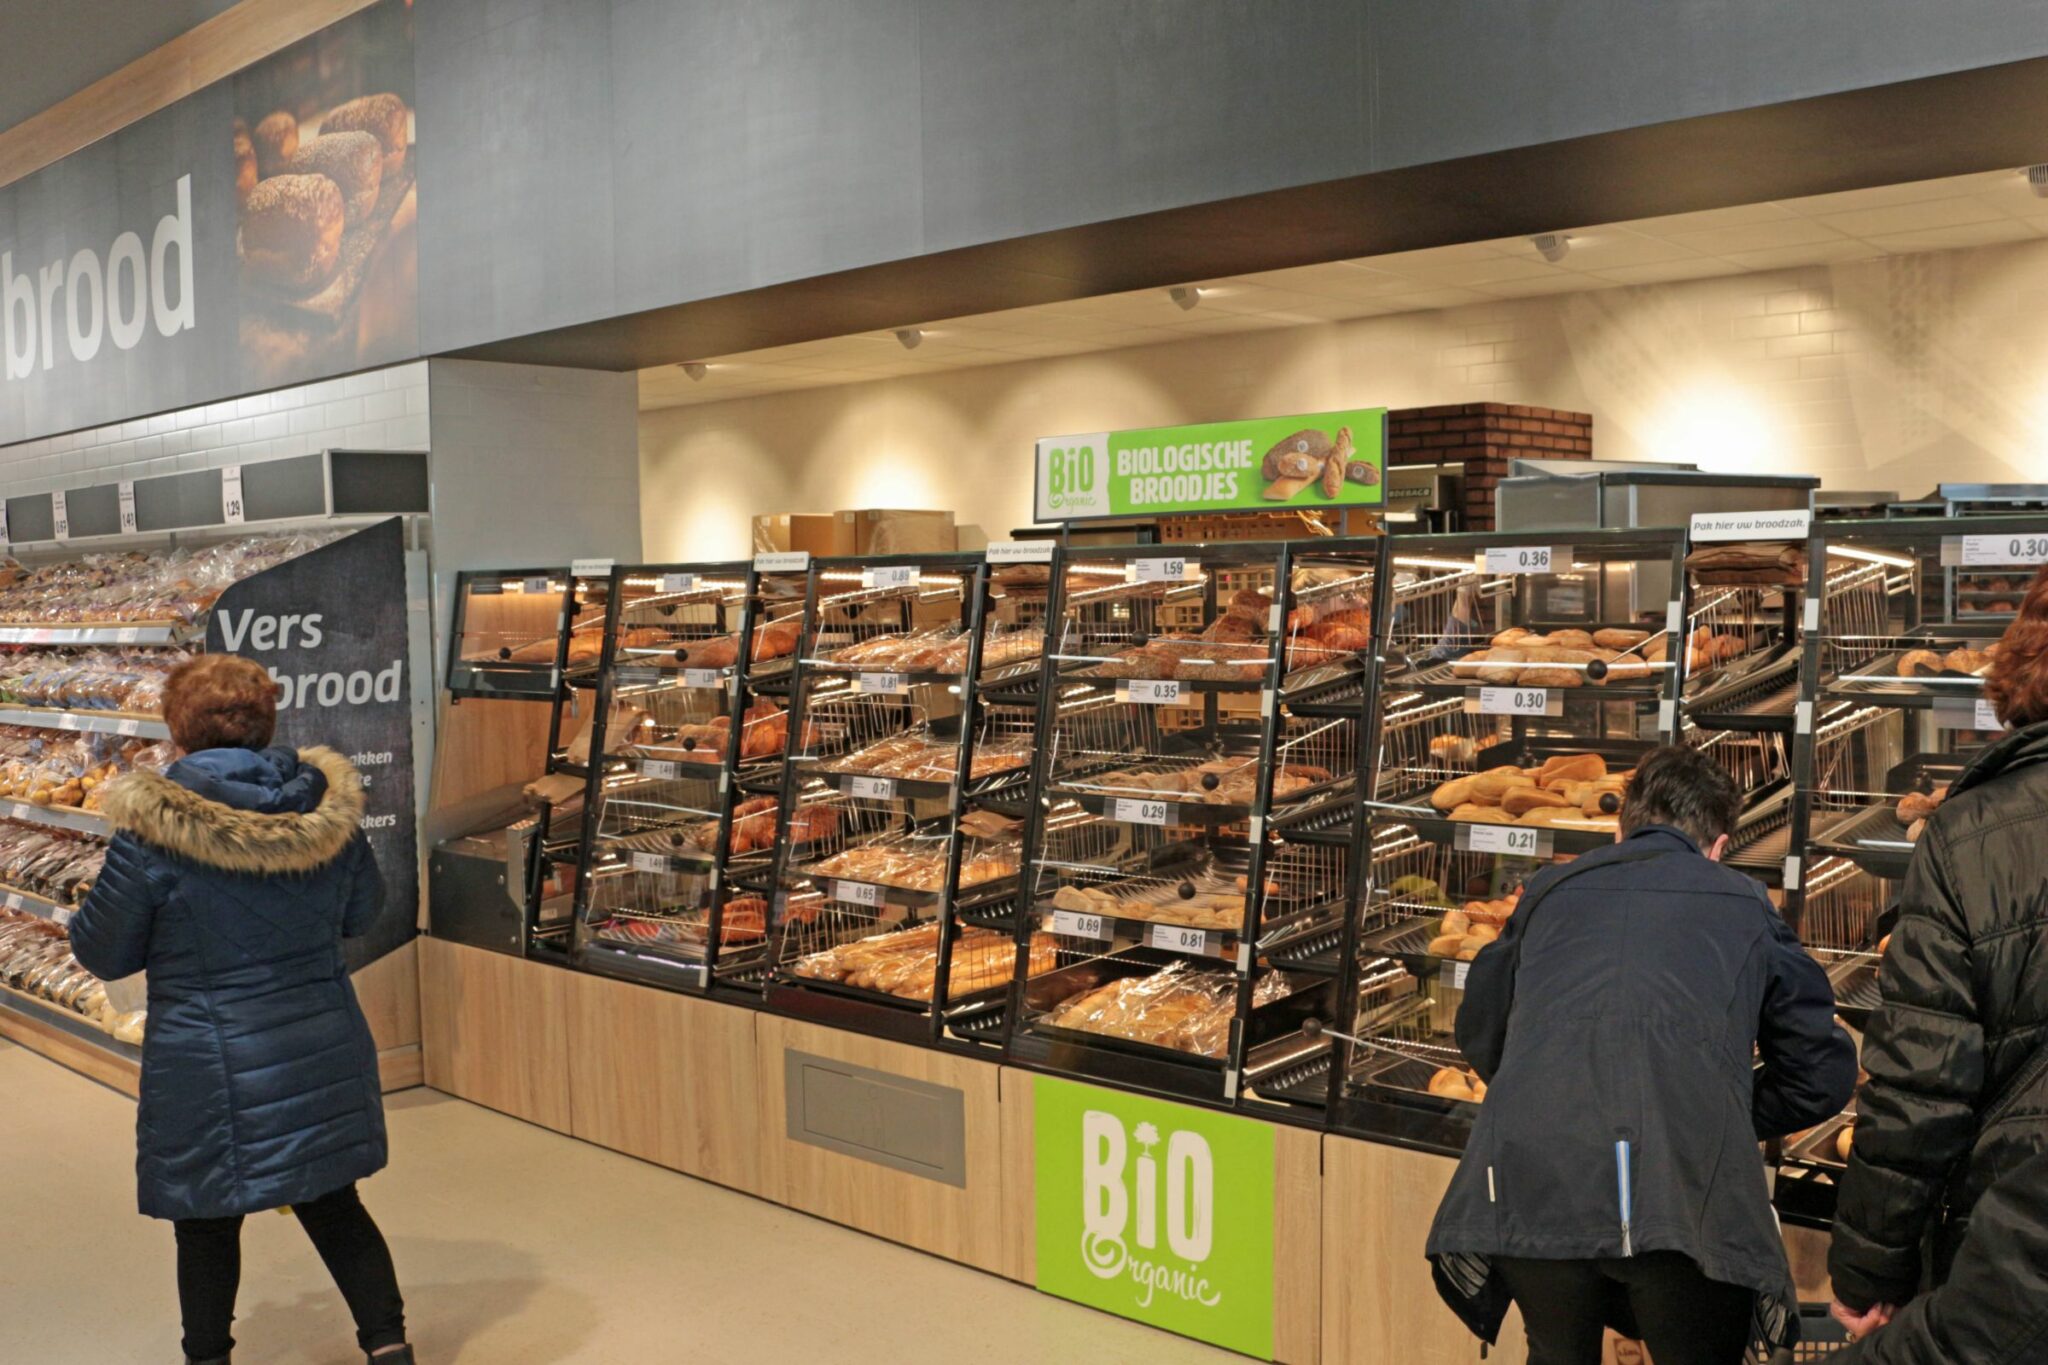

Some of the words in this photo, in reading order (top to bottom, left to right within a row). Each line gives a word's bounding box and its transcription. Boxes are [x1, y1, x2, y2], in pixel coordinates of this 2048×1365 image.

[2, 173, 195, 381] brood
[1117, 440, 1253, 476] BIOLOGISCHE
[1130, 472, 1238, 505] BROODJES
[226, 500, 240, 516] 1.29
[1694, 522, 1712, 530] Pak
[1715, 521, 1734, 530] hier
[1737, 521, 1752, 530] uw
[2009, 539, 2048, 557] 0.30
[1519, 551, 1548, 566] 0.36
[1163, 561, 1183, 575] 1.59
[217, 608, 323, 651] Vers
[880, 676, 897, 688] 0.81
[1154, 684, 1177, 698] 0.35
[1514, 692, 1544, 708] 0.30
[1142, 805, 1165, 819] 0.29
[1507, 831, 1534, 849] 0.21
[856, 887, 874, 900] 0.65
[1077, 917, 1099, 932] 0.69
[1180, 932, 1203, 948] 0.81
[1082, 1230, 1221, 1308] Organic
